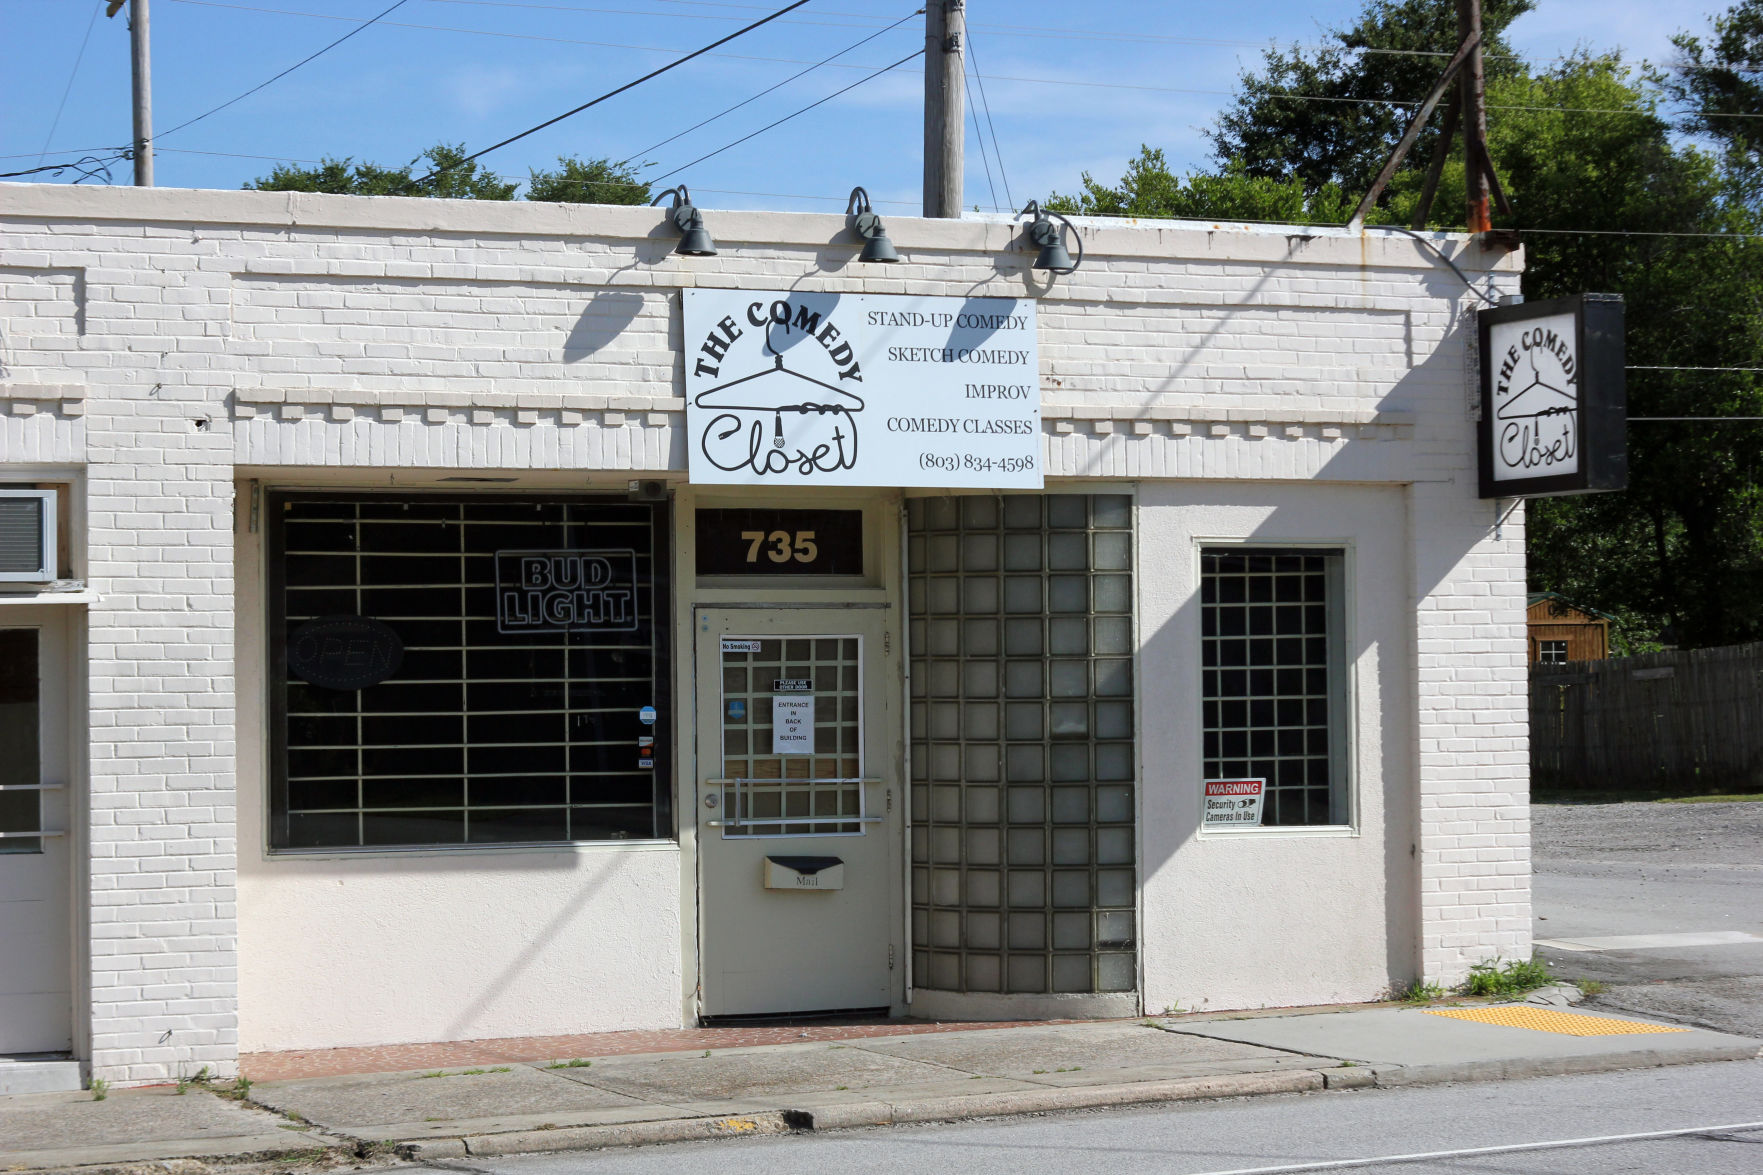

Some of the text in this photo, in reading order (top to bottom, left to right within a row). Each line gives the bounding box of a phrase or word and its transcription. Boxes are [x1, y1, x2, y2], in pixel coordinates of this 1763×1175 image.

[868, 311, 1028, 330] STAND-UP COMEDY
[694, 300, 863, 384] THE COMEDY
[888, 346, 1030, 365] SKETCH COMEDY
[1497, 327, 1577, 396] THE COMEDY
[965, 384, 1031, 400] IMPROV
[887, 417, 1033, 435] COMEDY CLASSES
[702, 413, 857, 476] Closet
[1500, 422, 1576, 468] Closet
[919, 452, 1034, 473] (803) 834-4598
[741, 530, 818, 563] 735
[521, 556, 612, 590] BUD
[504, 590, 631, 625] LIGHT
[296, 636, 394, 669] OPEN
[1208, 783, 1259, 794] WARNING
[1207, 799, 1236, 811] Security
[1205, 811, 1255, 822] Cameras In Use
[796, 876, 818, 887] Mail
